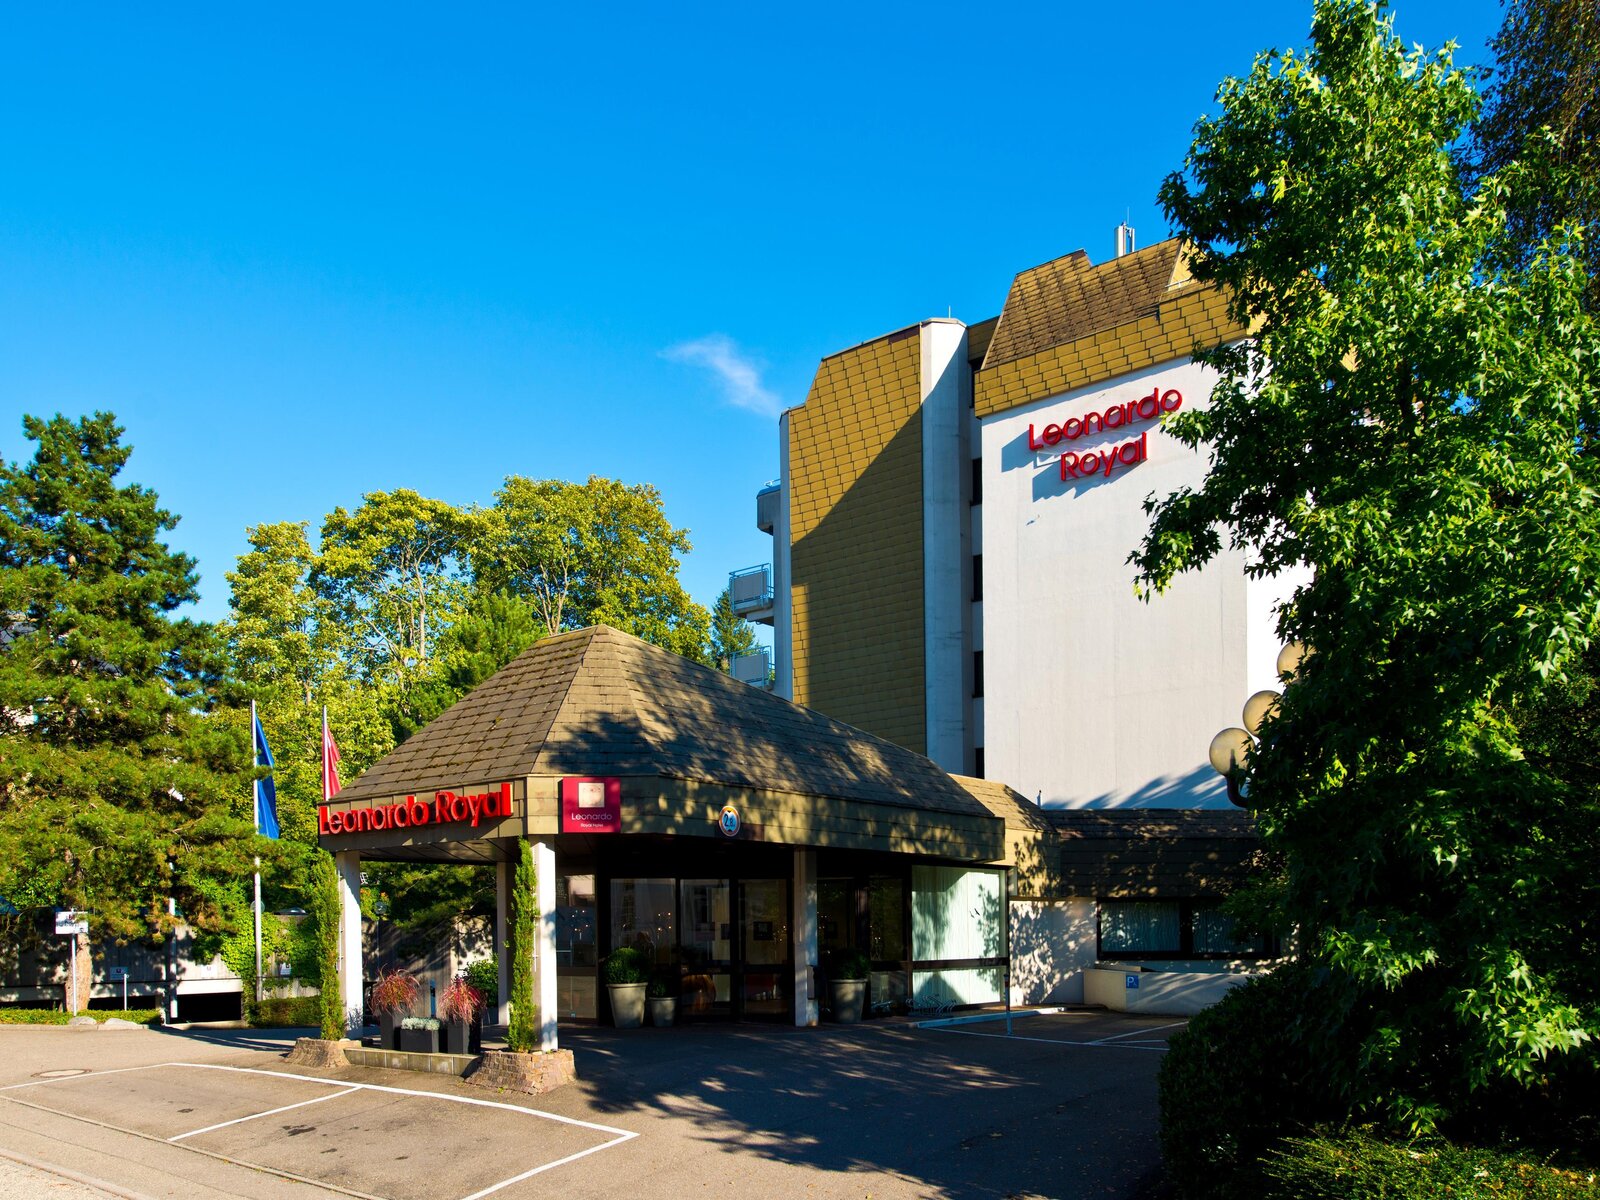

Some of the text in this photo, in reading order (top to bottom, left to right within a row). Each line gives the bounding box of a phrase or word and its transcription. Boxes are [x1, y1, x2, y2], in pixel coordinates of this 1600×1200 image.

[1028, 387, 1183, 450] Leonardo
[1060, 431, 1148, 481] Royal
[319, 783, 513, 835] Leonardo Royal
[571, 812, 612, 820] Leonardo
[1127, 976, 1135, 987] P
